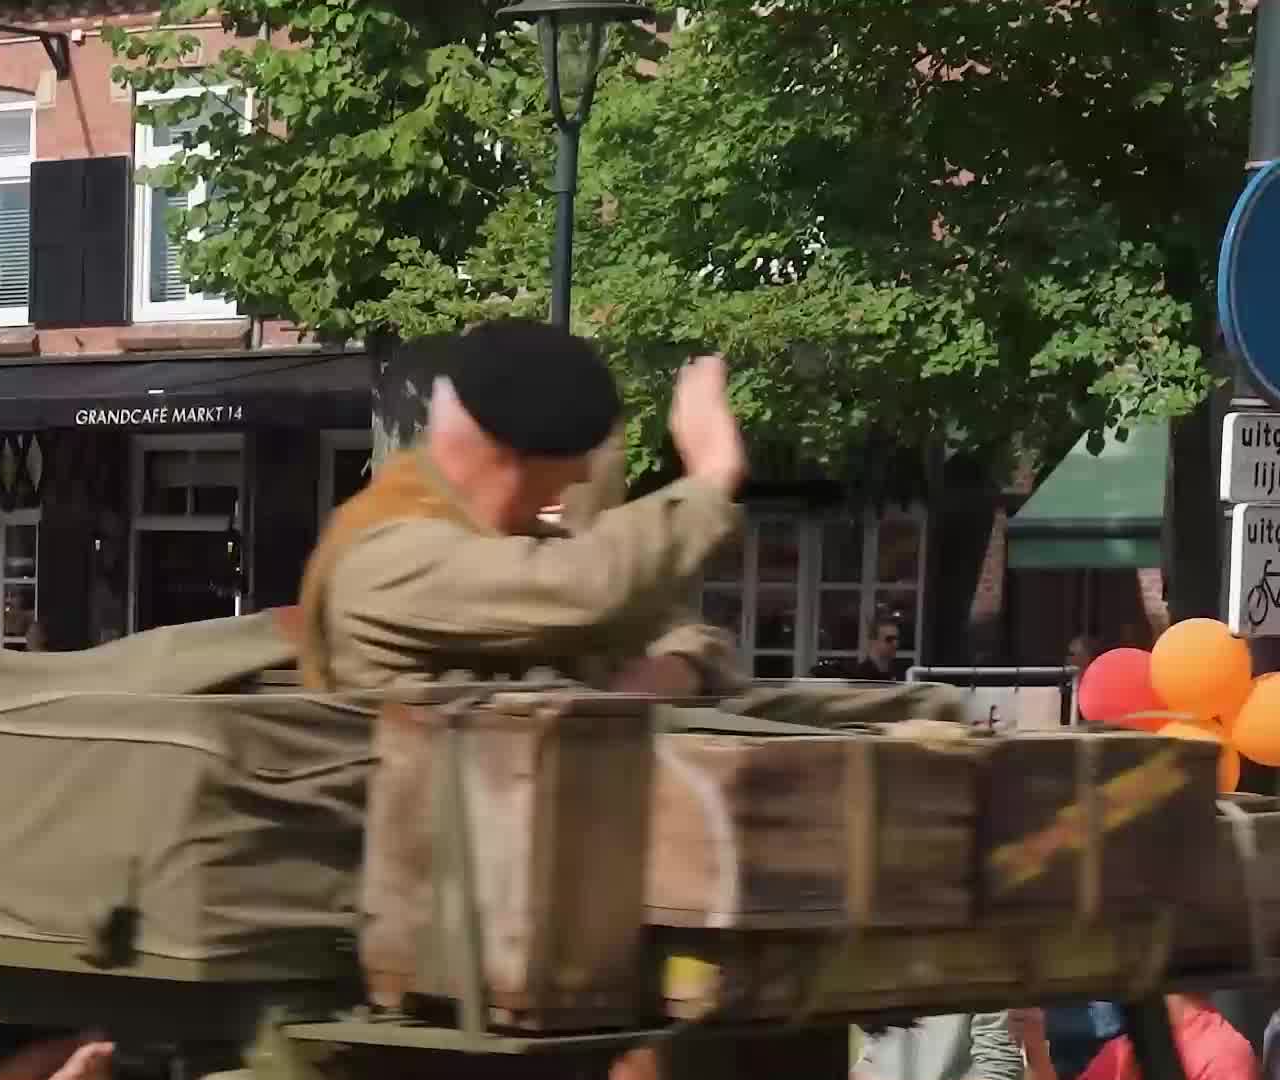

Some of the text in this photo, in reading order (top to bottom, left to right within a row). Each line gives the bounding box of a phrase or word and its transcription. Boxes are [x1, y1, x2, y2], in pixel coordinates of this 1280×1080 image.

[171, 406, 225, 423] MARKT
[227, 404, 243, 421] 14
[1254, 461, 1280, 496] lij
